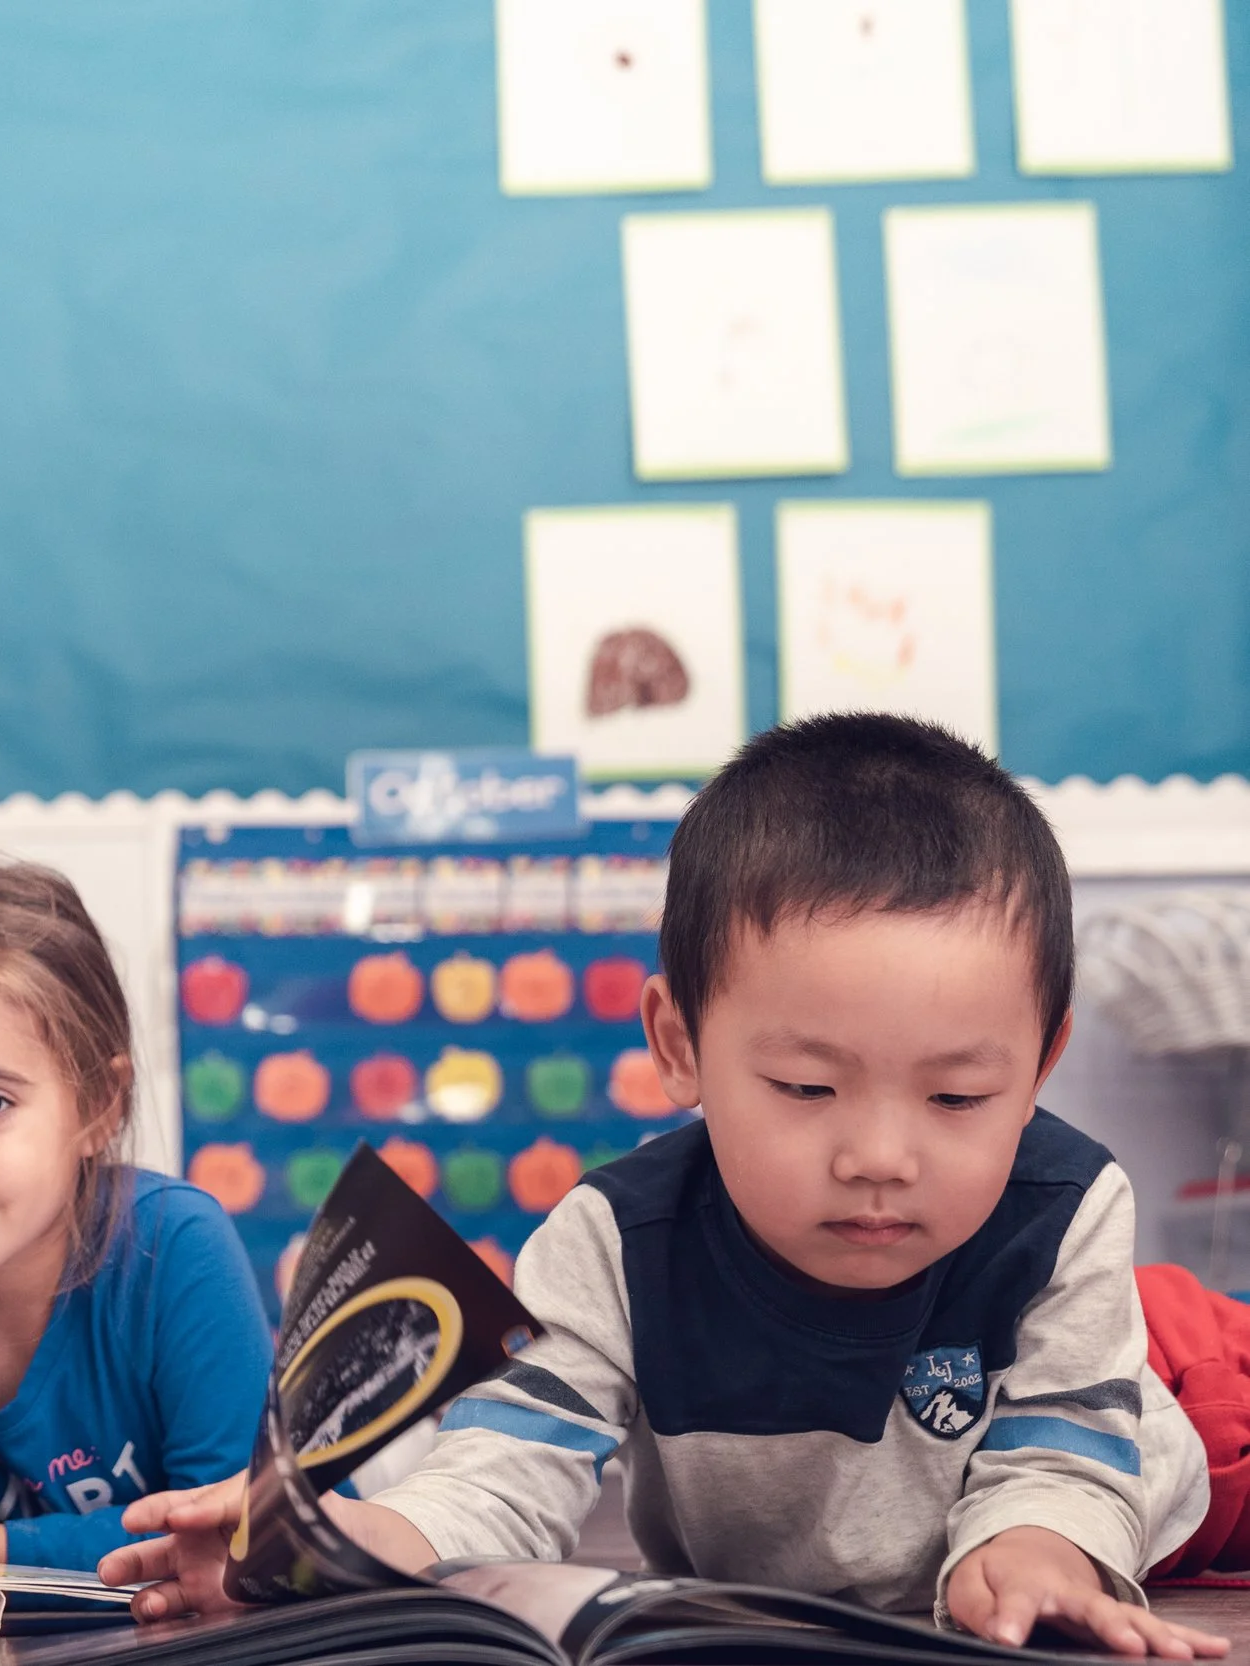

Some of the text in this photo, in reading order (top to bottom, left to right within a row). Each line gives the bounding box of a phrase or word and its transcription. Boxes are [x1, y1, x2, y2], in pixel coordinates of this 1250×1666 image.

[926, 1355, 953, 1383] J&J
[905, 1373, 982, 1397] EST 2002
